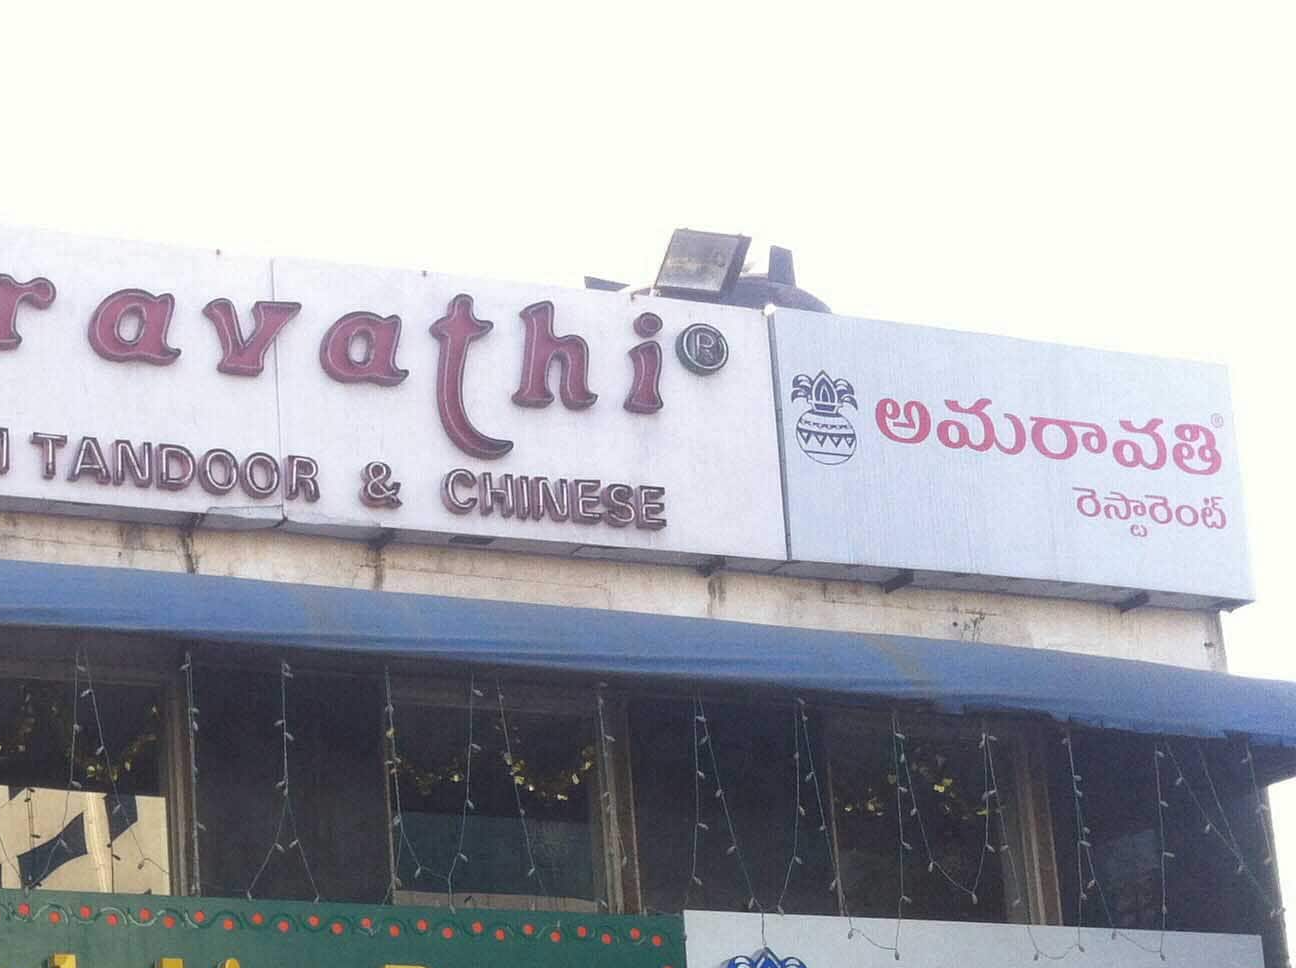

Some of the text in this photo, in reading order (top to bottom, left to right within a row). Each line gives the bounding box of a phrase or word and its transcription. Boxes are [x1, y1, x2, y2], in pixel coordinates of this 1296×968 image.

[875, 397, 1224, 475] అమరావతి
[30, 431, 321, 502] TANDOOR
[360, 461, 403, 508] &
[440, 467, 668, 530] CHINESE
